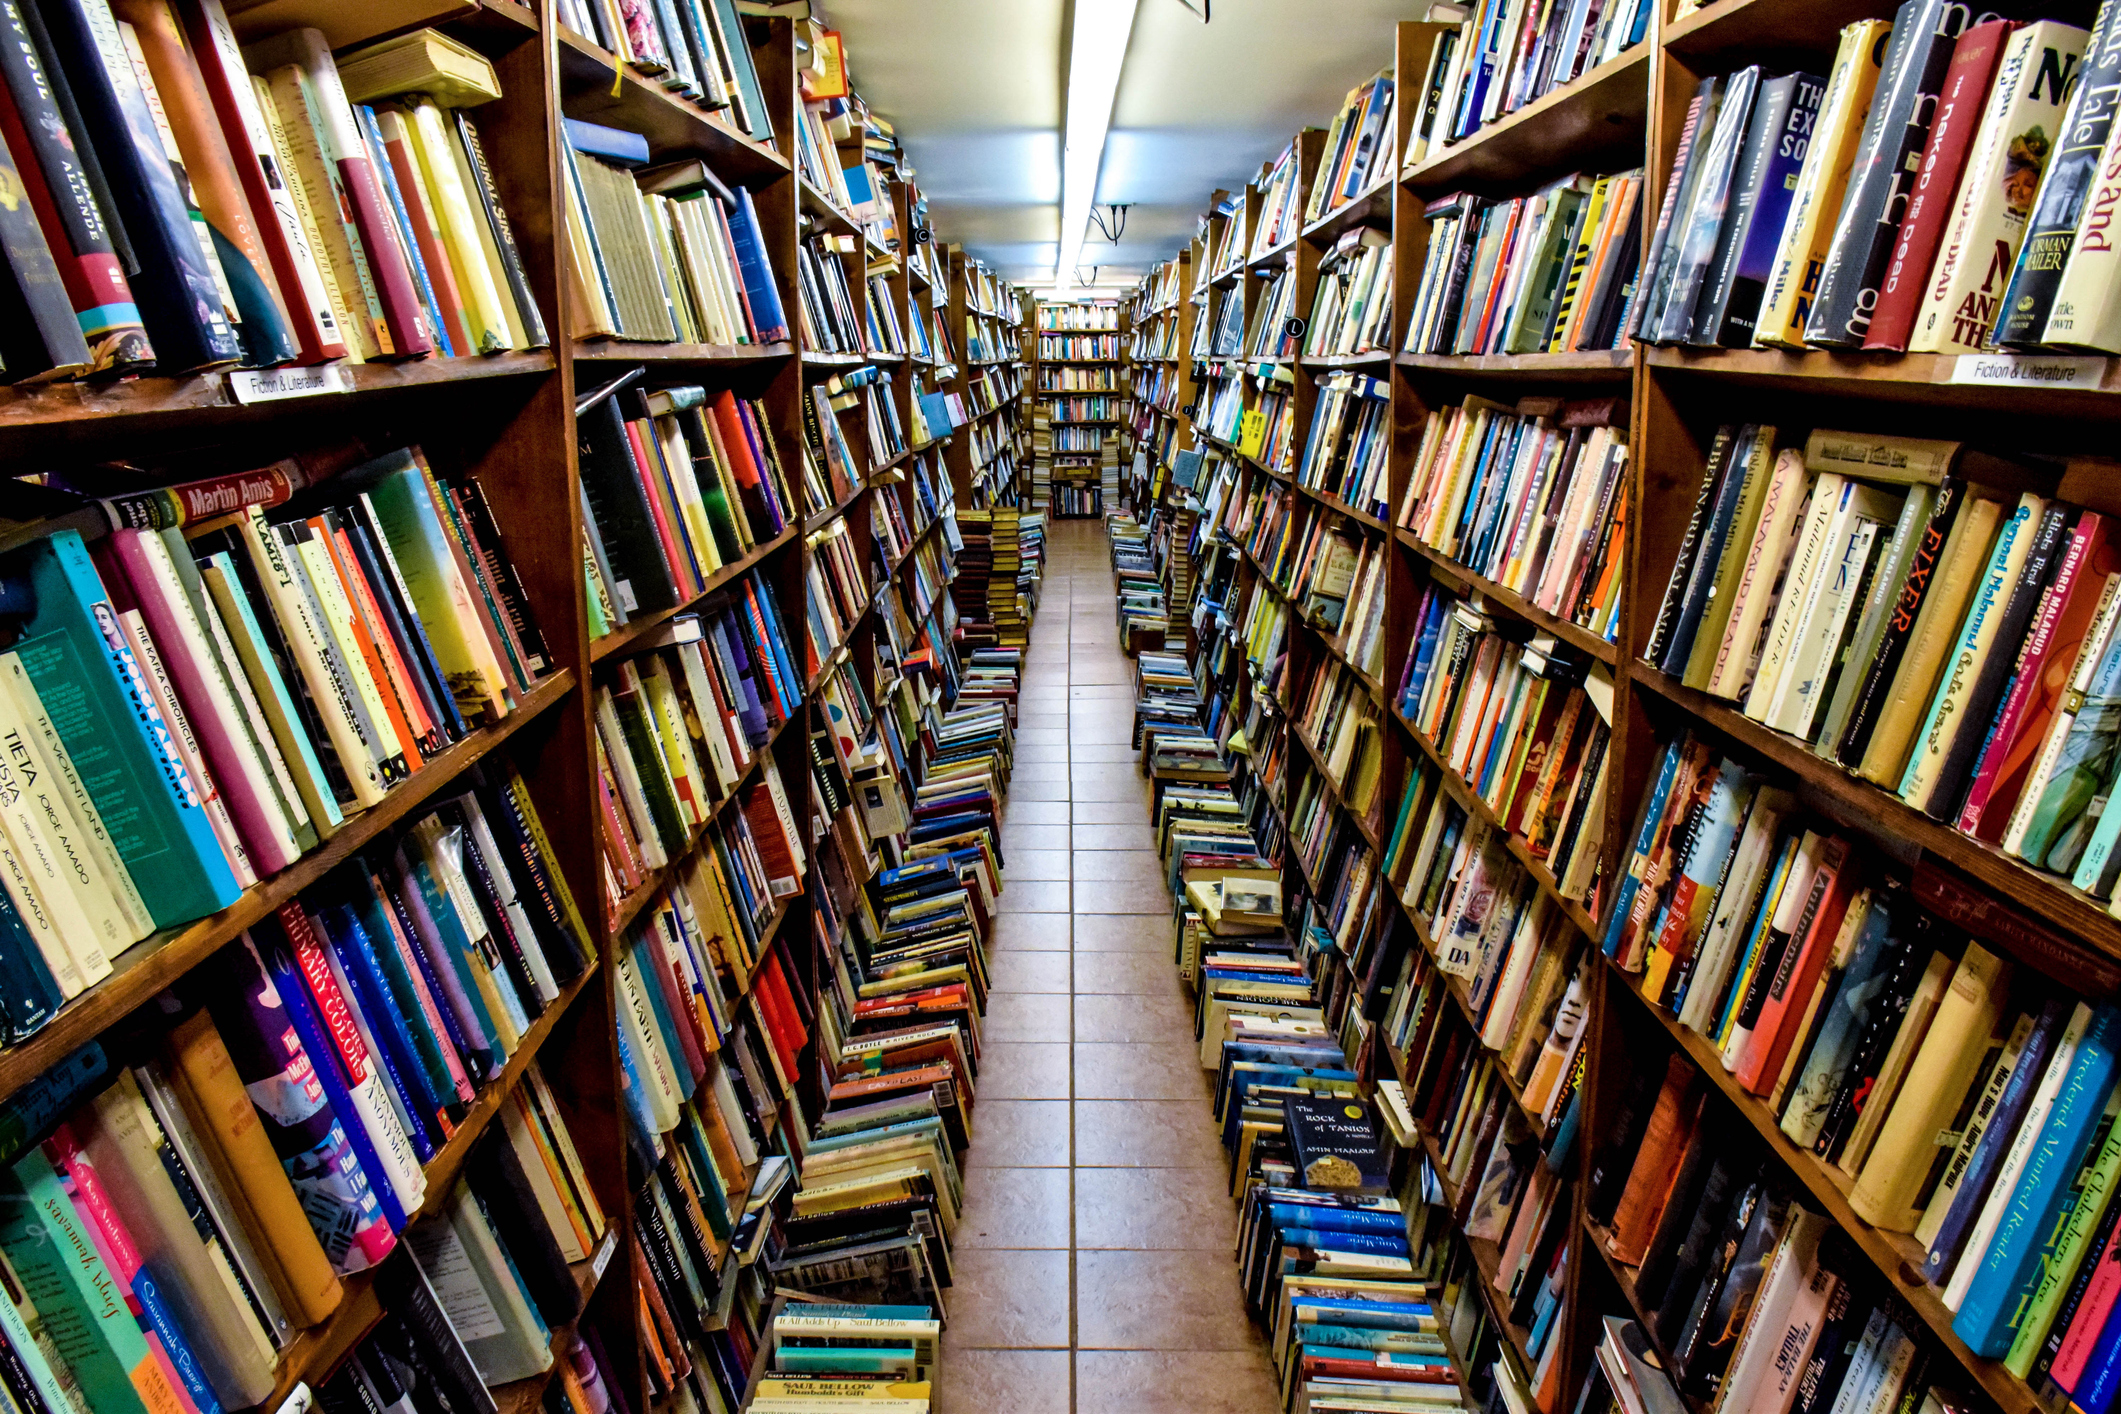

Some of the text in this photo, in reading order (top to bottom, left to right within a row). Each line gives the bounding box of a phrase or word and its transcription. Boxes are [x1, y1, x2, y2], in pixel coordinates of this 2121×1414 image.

[1998, 35, 2033, 116] Norman
[464, 119, 514, 245] ORIGINAL SINS
[1654, 93, 1704, 230] NORMAN MAILER
[1747, 107, 1774, 187] NORMAN MAILER
[62, 160, 100, 242] ALLENDE
[918, 230, 926, 239] C
[234, 214, 258, 267] LOVER
[1712, 212, 1744, 304] THE EXECUTIONER'S SONG
[1821, 249, 1843, 301] ghost
[1933, 242, 1961, 303] DEAD
[1291, 321, 1298, 334] L
[249, 370, 324, 394] Fiction & Literature
[1974, 362, 2076, 381] Fiction & Literature
[188, 477, 274, 517] Martin Amis
[1507, 471, 1547, 551] LIEBLING
[1933, 485, 1954, 519] The
[372, 516, 411, 602] MARTIN AMIS
[1583, 528, 1598, 551] TALE
[1648, 451, 1720, 656] BERNARD MALAMUD
[1711, 457, 1789, 686] A MALAMUD READER
[1771, 485, 1834, 664] A Malamud READER
[1873, 502, 1914, 604] BERNARD MALAMUD
[2024, 509, 2063, 587] Idiots First
[1892, 524, 1942, 631] FIXER
[1964, 503, 2032, 650] Bernard Malamud
[2031, 534, 2086, 655] BERNARD MALAMUD
[2013, 584, 2052, 670] IDIOTS FIRST
[2064, 579, 2116, 693] The Magic Barrel
[137, 626, 198, 754] THE KAFKA CHRONICLES
[297, 604, 355, 733] STANLEY AND THE WOMEN
[364, 655, 393, 711] MONEY
[1924, 651, 1973, 754] God's Grace
[4, 728, 37, 787] TIETA
[38, 715, 105, 841] THE VIOLENT LAND
[2015, 734, 2061, 834] bernard malamud
[18, 813, 54, 878] JORGE AMADO
[37, 794, 90, 885] JORGE AMADO
[608, 806, 639, 871] JULIAN BARNES
[1677, 803, 1703, 868] malone
[3, 849, 48, 930] JORGE AMADO
[1628, 859, 1659, 926] PAUL MALMONT
[1746, 910, 1772, 969] FLY AWAY PETER
[1769, 875, 1831, 996] Antimemoirs
[282, 908, 367, 1078] PRIMARY COLORS
[614, 957, 656, 1045] JOHN BARTH
[1235, 995, 1278, 1004] GOLDEN
[859, 1039, 880, 1050] BOYLE
[891, 1029, 935, 1045] RIVER ROCK
[364, 1086, 411, 1178] ANONYMOUS
[1296, 1105, 1313, 1113] The
[1314, 1124, 1371, 1133] of TANIOS
[1993, 1028, 2076, 1199] Mandeville The Fable of the Bees
[1334, 1147, 1376, 1155] MAALOUF
[1989, 1047, 2101, 1269] Frederick Manfred Reader
[645, 1206, 667, 1239] Night
[660, 1240, 682, 1279] Season
[808, 1210, 835, 1219] Bellow
[1341, 1211, 1396, 1227] Ann-Marie
[1347, 1236, 1397, 1251] Ann-Marie
[2038, 1136, 2121, 1304] The Chokecherry Tree
[142, 1281, 204, 1395] Savannah Breeze
[826, 1318, 840, 1328] Up
[849, 1318, 908, 1327] Saul Bellow
[1772, 1323, 1801, 1374] TRILOGY
[1777, 1321, 1812, 1395] THE BALKAN
[819, 1382, 874, 1390] BELLOW
[1797, 1359, 1817, 1396] TRILOGY
[1798, 1356, 1826, 1412] THE LEVANT
[1840, 1337, 1880, 1388] perfect
